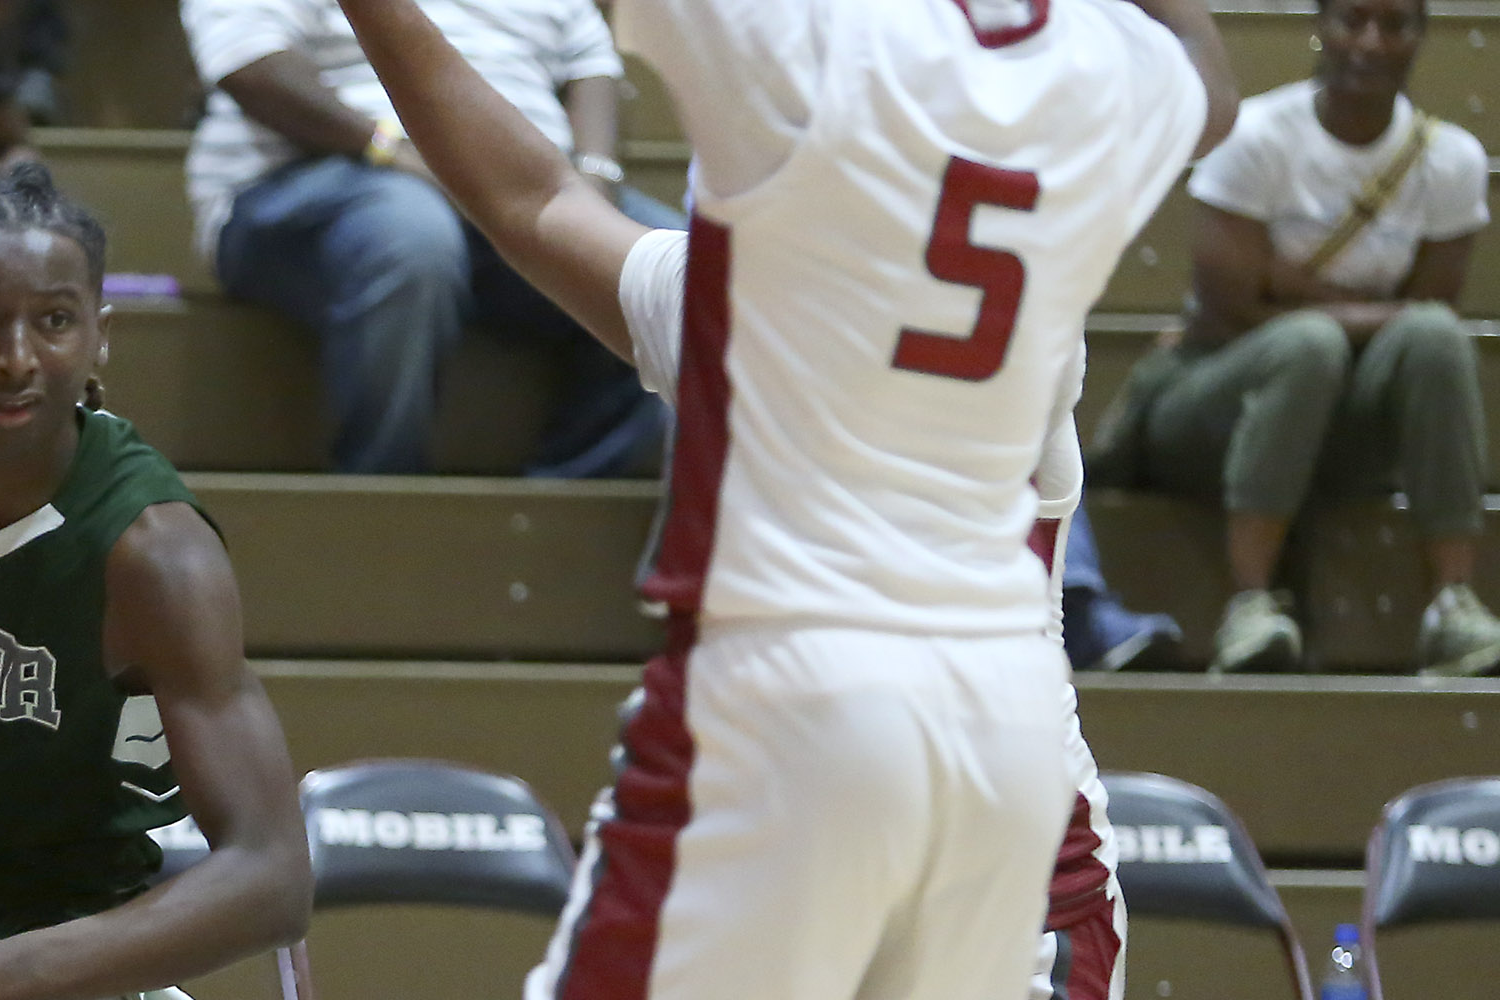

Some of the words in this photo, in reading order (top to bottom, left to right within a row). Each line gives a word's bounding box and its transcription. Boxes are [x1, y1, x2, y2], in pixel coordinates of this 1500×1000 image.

[891, 155, 1040, 382] 5
[318, 808, 548, 852] MOBILE
[1115, 825, 1232, 863] BILE
